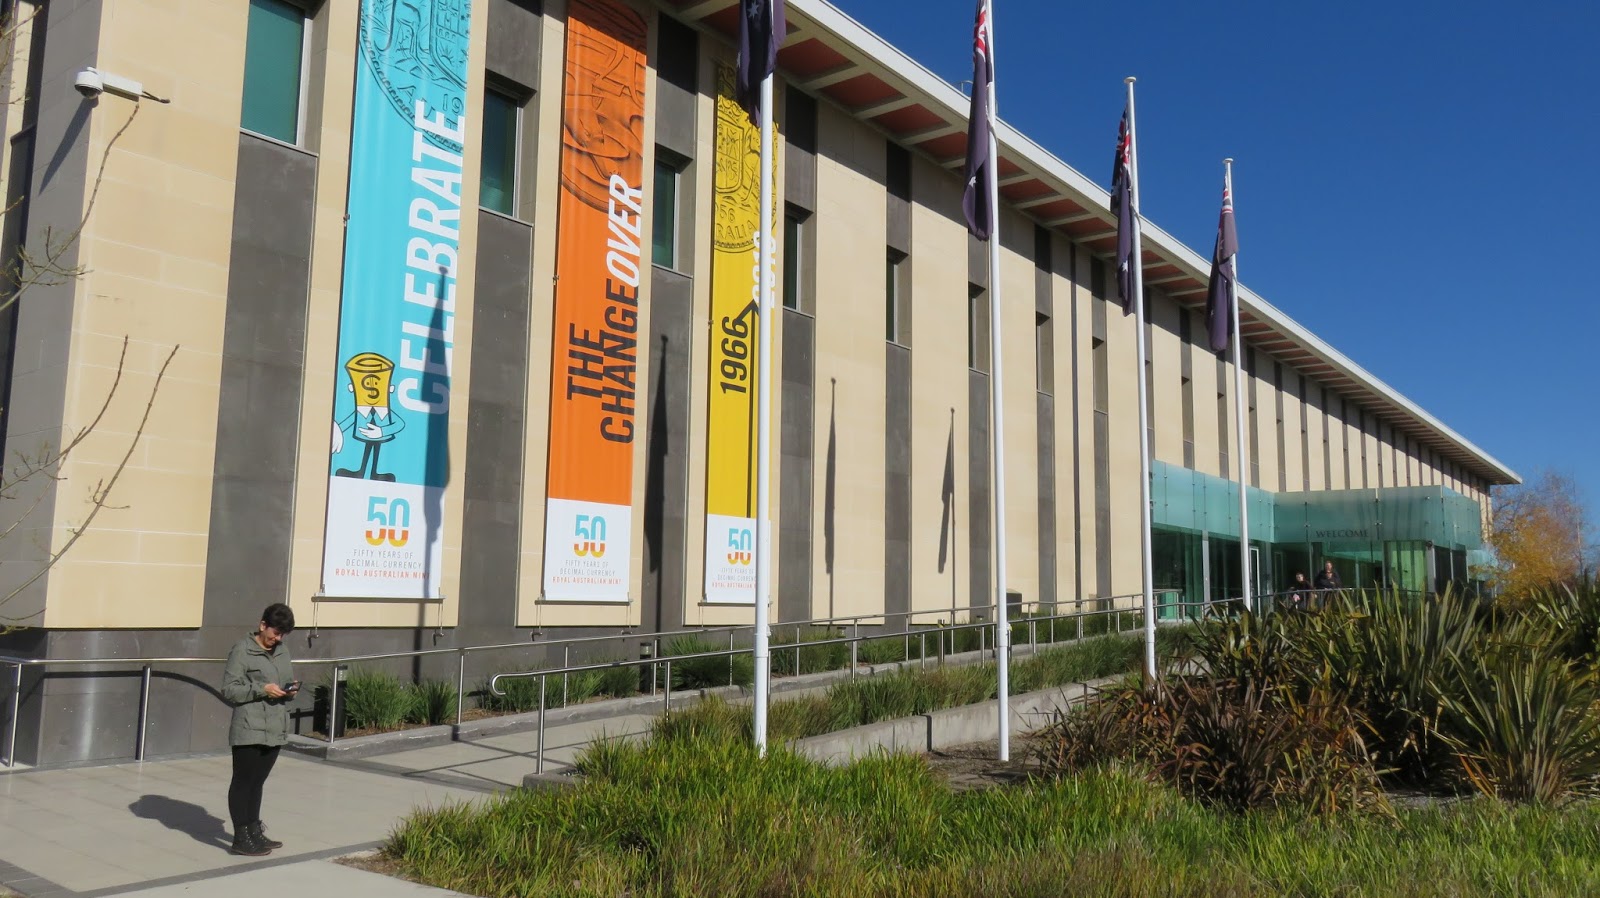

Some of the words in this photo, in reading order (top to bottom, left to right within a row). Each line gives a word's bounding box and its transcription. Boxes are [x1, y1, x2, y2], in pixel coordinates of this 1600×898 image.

[397, 99, 466, 415] CELEBRATE
[566, 323, 604, 400] THE
[720, 316, 749, 394] 1966
[365, 496, 410, 547] 50
[574, 514, 606, 558] 50
[1315, 529, 1369, 538] WELCOME
[346, 559, 379, 567] DECIMAL
[383, 560, 422, 569] CURRENCY
[353, 549, 375, 557] FIFTY
[378, 550, 401, 559] YEARS
[727, 527, 752, 565] 50
[335, 568, 360, 576] ROYAL
[364, 569, 409, 578] AUSTRALIAN
[560, 567, 584, 575] DECIMAL
[587, 569, 615, 577] CURRENCY
